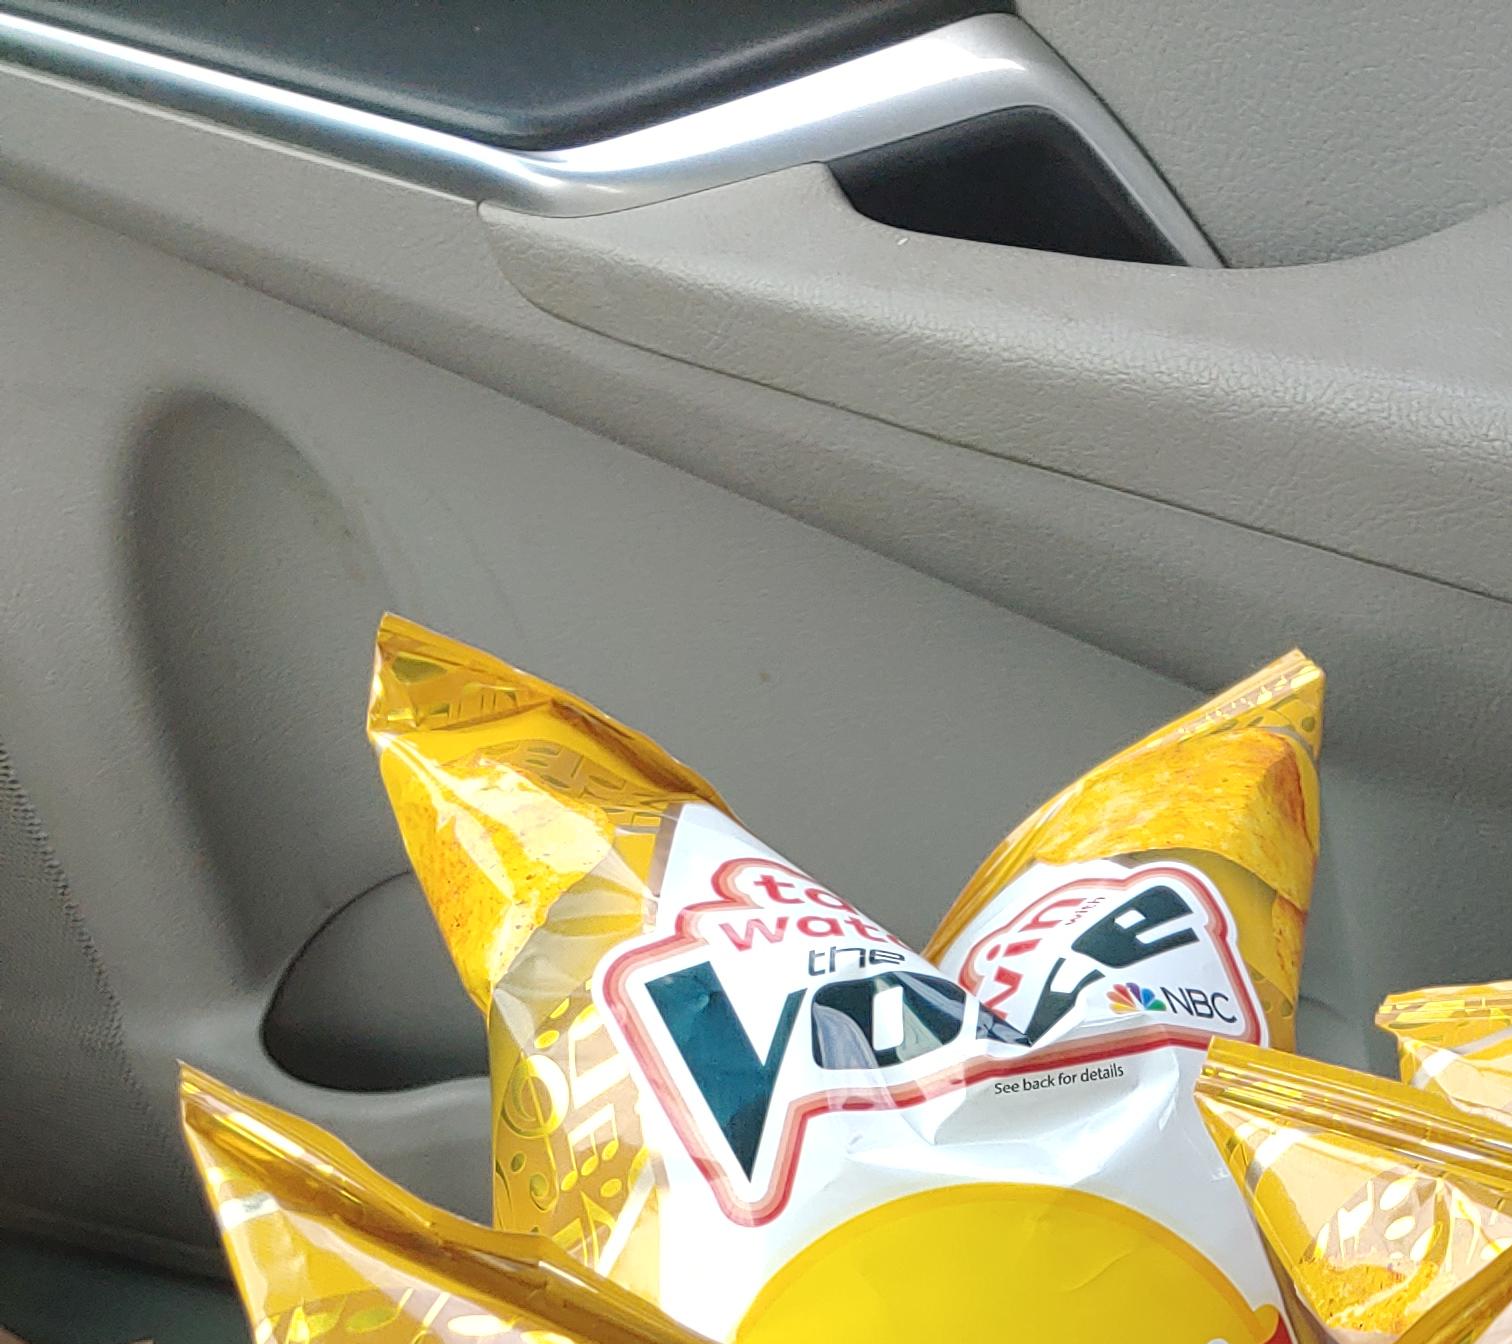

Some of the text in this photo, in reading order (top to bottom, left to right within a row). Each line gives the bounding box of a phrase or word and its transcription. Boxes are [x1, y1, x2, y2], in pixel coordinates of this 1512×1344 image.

[1063, 896, 1107, 927] with
[807, 944, 906, 978] the
[1163, 985, 1238, 1024] NBC
[993, 1062, 1125, 1096] See back for details
